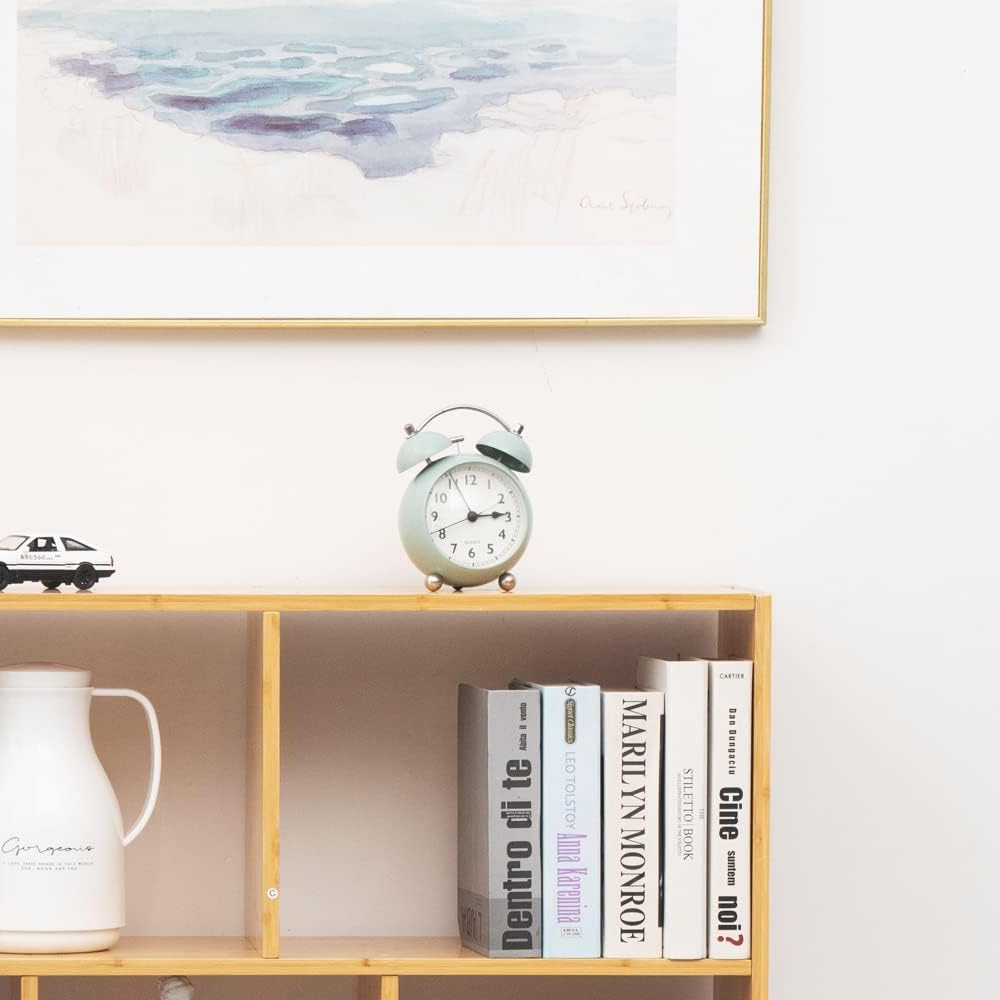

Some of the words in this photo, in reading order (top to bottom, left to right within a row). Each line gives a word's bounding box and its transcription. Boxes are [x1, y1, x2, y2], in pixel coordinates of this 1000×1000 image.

[464, 474, 478, 486] 12
[434, 493, 448, 504] 10
[497, 493, 505, 504] 2
[431, 511, 438, 522] 9
[504, 511, 512, 523] 3
[438, 528, 446, 540] 8
[498, 529, 506, 540] 4
[450, 543, 458, 555] 7
[468, 547, 476, 559] 6
[487, 543, 494, 555] 5
[719, 672, 745, 680] CARTIER
[519, 702, 527, 722] vento
[728, 708, 737, 726] Dan
[518, 733, 527, 752] Abita
[727, 729, 737, 775] Dungaciu
[564, 751, 576, 774] LEO
[620, 698, 648, 821] MARILYN
[501, 759, 532, 791] te
[564, 775, 576, 830] TOLSTOY
[683, 768, 694, 823] STILETTO
[500, 800, 533, 829] di
[718, 786, 744, 840] Cine
[1, 836, 95, 857] Gorgeous
[556, 832, 588, 864] Anna
[683, 828, 694, 861] BOOK
[727, 850, 737, 886] suntem
[501, 840, 534, 951] Dentro
[556, 867, 588, 924] Karenina
[619, 828, 647, 943] MONROE
